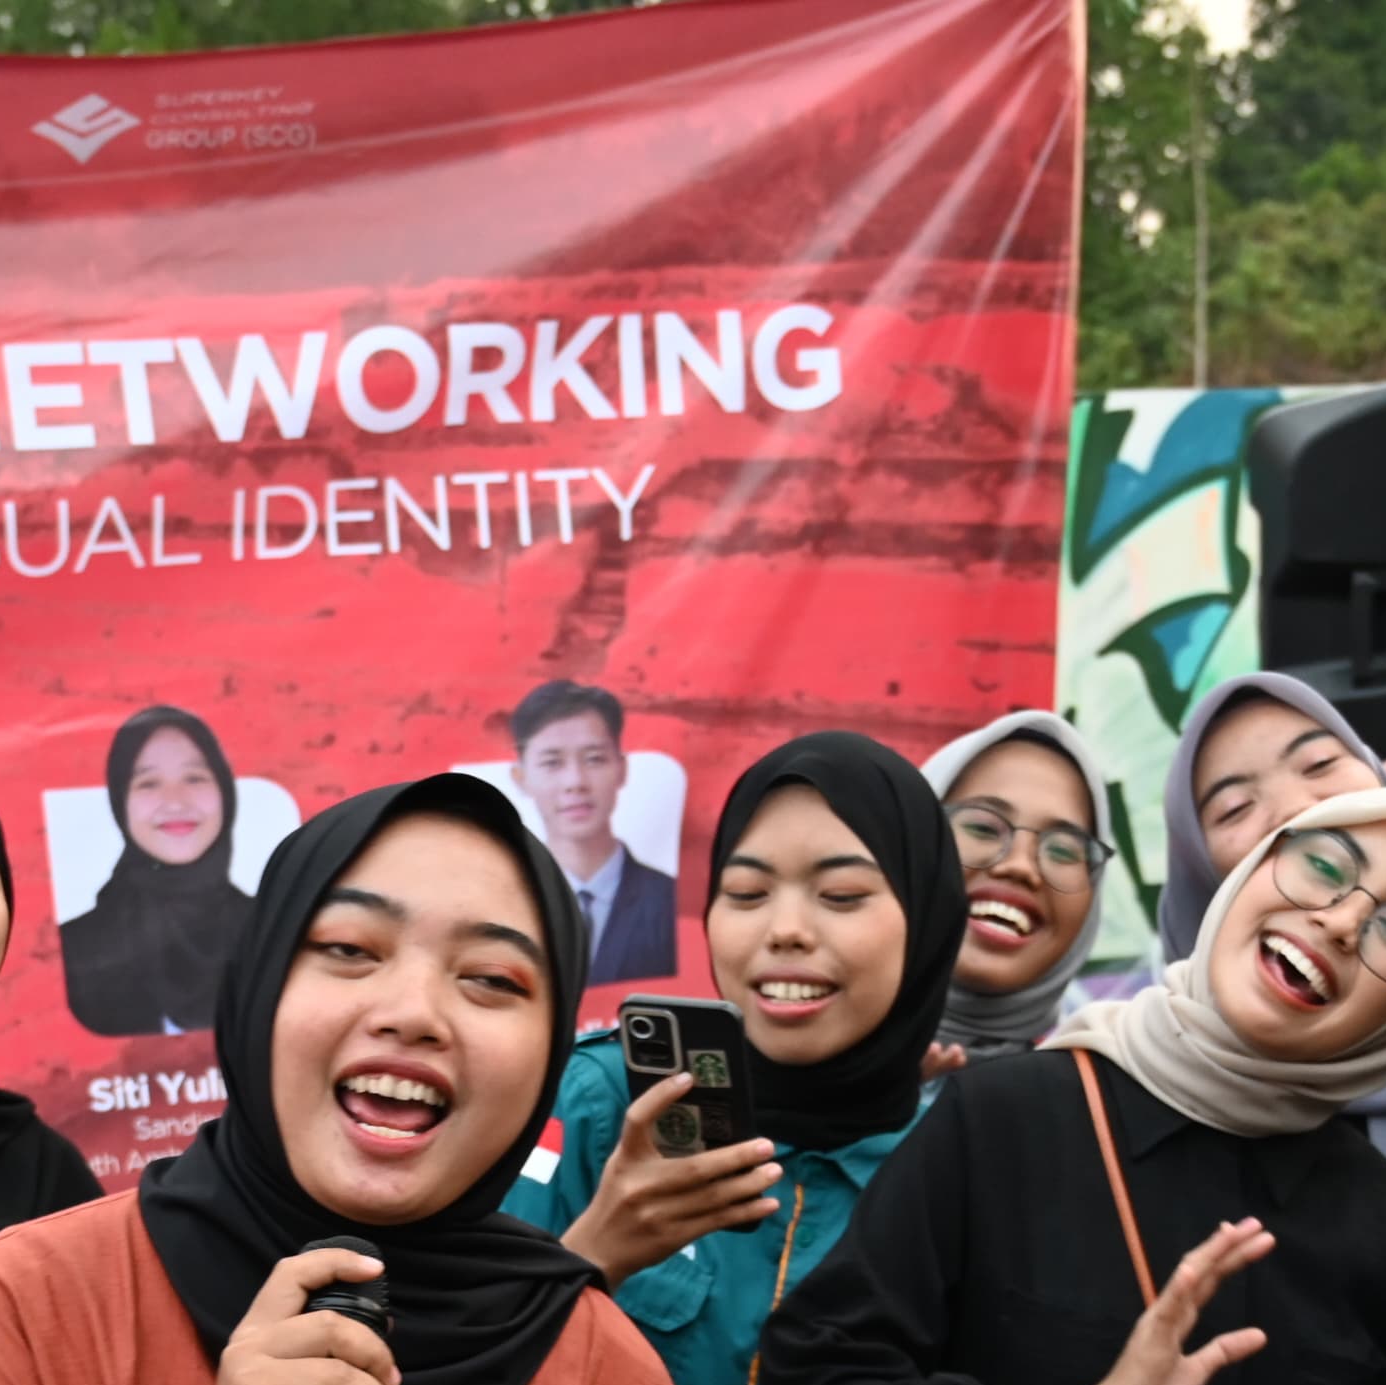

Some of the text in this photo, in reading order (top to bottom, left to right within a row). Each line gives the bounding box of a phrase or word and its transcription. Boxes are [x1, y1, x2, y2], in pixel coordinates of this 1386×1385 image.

[145, 127, 235, 150] GROUP
[232, 463, 656, 562] IDENTITY
[88, 1072, 150, 1112] Siti
